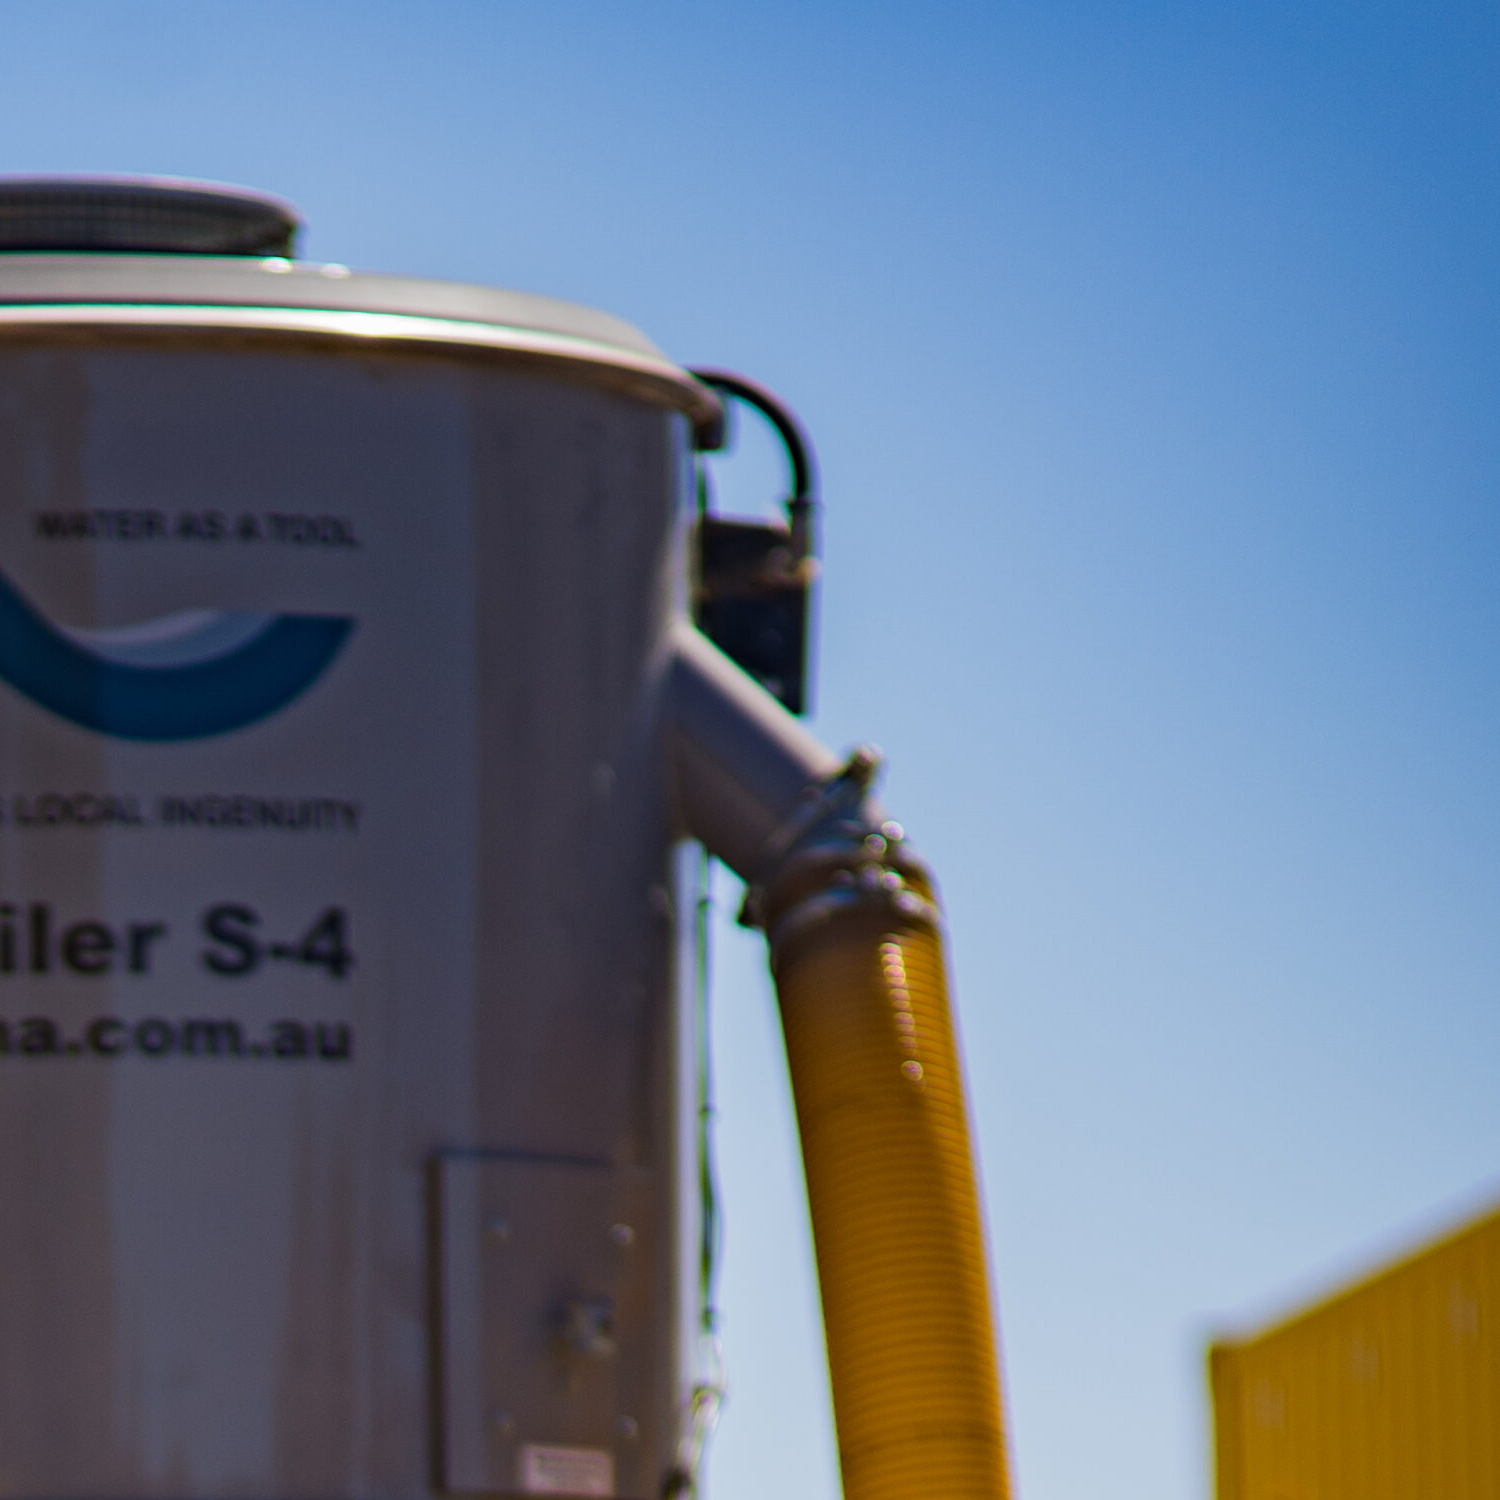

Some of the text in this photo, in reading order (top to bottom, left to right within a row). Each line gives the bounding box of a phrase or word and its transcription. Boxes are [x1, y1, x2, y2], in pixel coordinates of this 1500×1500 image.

[35, 510, 360, 548] WATER AS A TOOL
[13, 797, 141, 827] LOCAL
[161, 799, 362, 833] INGENUITY
[202, 904, 355, 979] S-4
